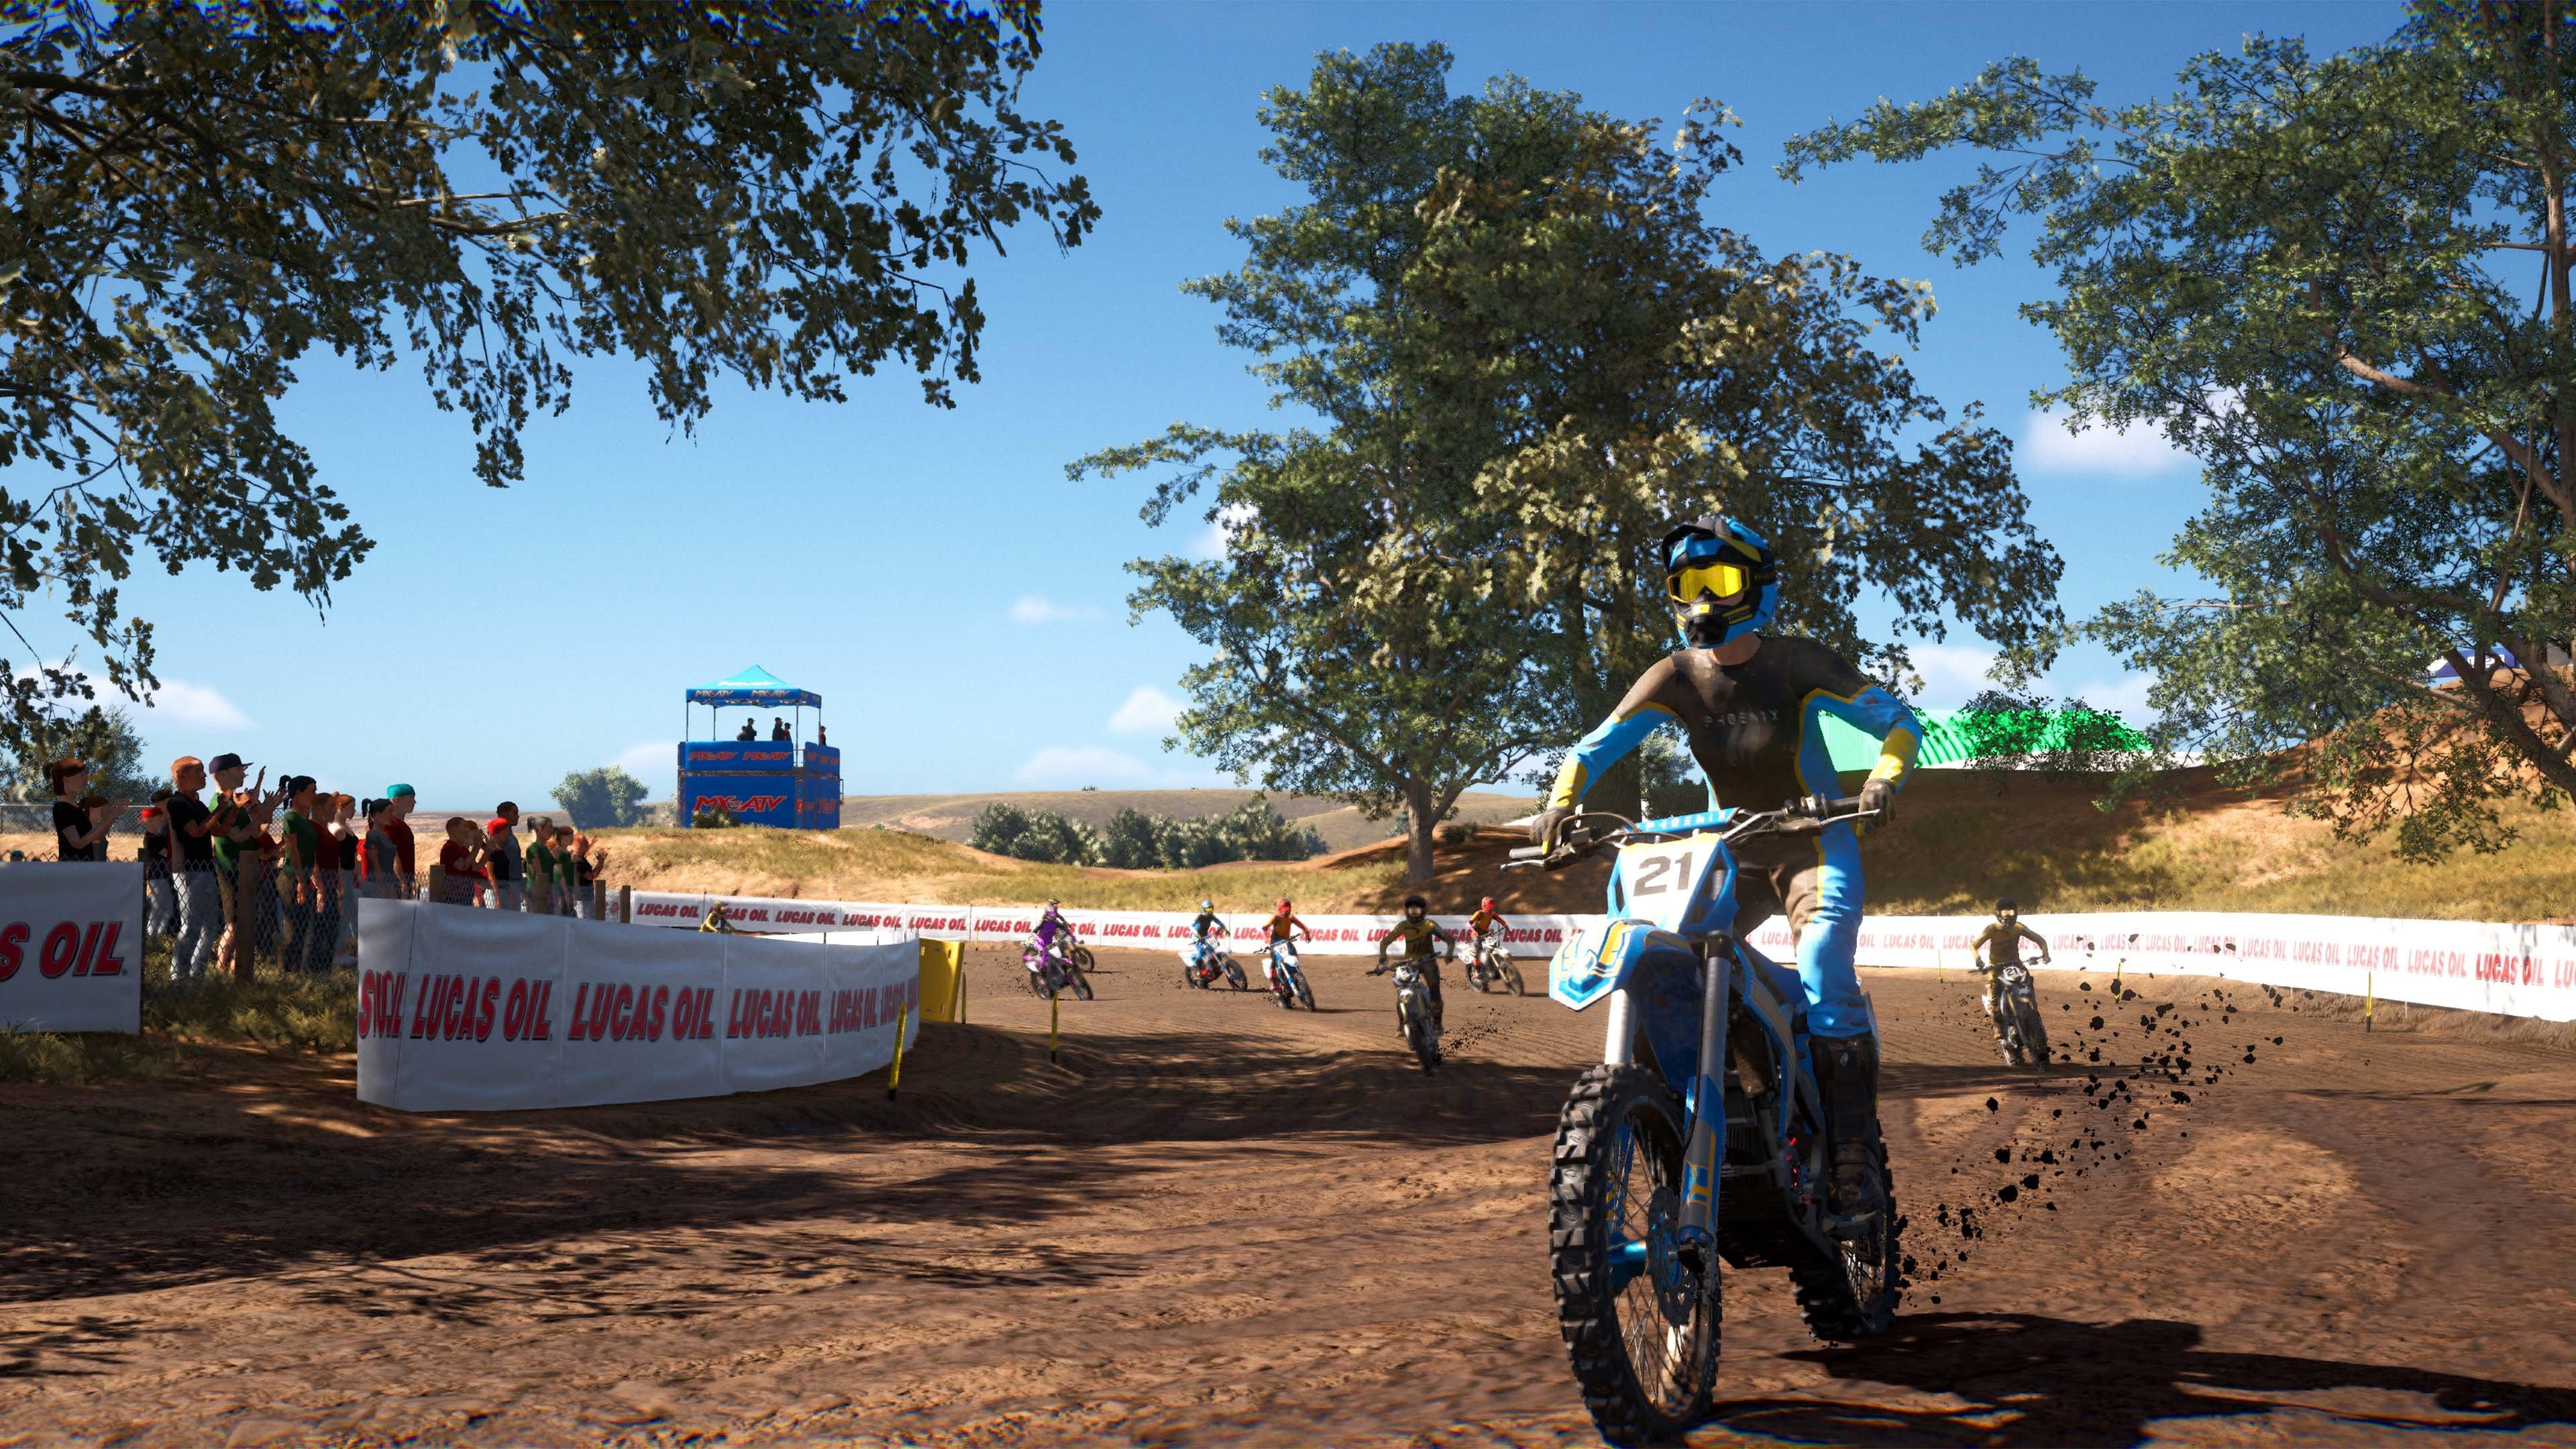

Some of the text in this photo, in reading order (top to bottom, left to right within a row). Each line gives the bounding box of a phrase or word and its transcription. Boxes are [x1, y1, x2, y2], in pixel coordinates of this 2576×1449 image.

[735, 796, 788, 812] ATV
[1633, 851, 1693, 897] 21
[637, 903, 700, 918] LUCAS OIL
[749, 910, 769, 921] OIL
[775, 910, 837, 925] LUCAS OIL
[842, 914, 902, 928] LUCAS OIL
[908, 917, 967, 931] LUCAS OIL
[974, 919, 1032, 934] LUCAS OIL
[1077, 923, 1097, 935] OIL
[1102, 924, 1161, 938] LUCAS OIL
[1341, 928, 1360, 941] OIL
[1544, 928, 1562, 943] OIL
[1859, 934, 1876, 947] OIL
[1882, 934, 1935, 949] LUCAS OIL
[2194, 934, 2220, 955] LUCA
[38, 921, 124, 979] OIL
[2242, 937, 2287, 961] LUCAS OIL
[2292, 941, 2341, 966] LUCAS OIL
[2347, 943, 2400, 971] LUCAS OIL
[2407, 949, 2467, 979] LUCAS OIL
[2006, 967, 2019, 976] 21
[2475, 953, 2544, 986] LUCAS OIL
[409, 974, 500, 1042] LUCAS
[503, 977, 553, 1042] OIL
[568, 982, 714, 1042] LUCAS OIL
[727, 988, 822, 1038] LUCAS OIL
